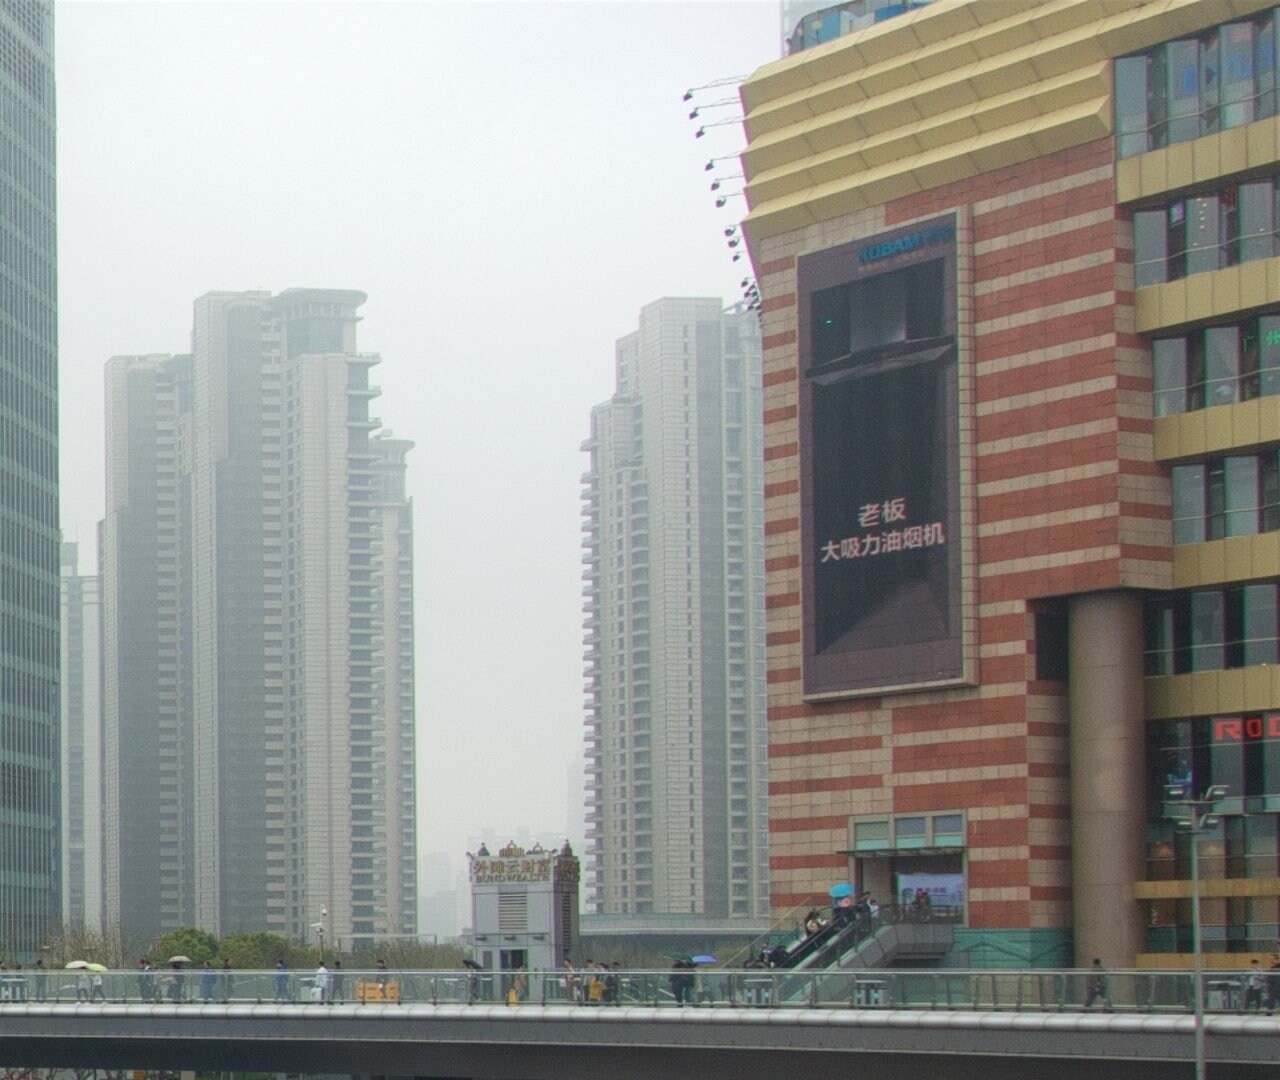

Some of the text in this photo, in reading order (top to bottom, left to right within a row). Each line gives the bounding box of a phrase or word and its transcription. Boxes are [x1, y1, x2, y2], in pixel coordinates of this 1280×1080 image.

[858, 498, 907, 528] 老板
[820, 522, 945, 563] 大吸力油烟机
